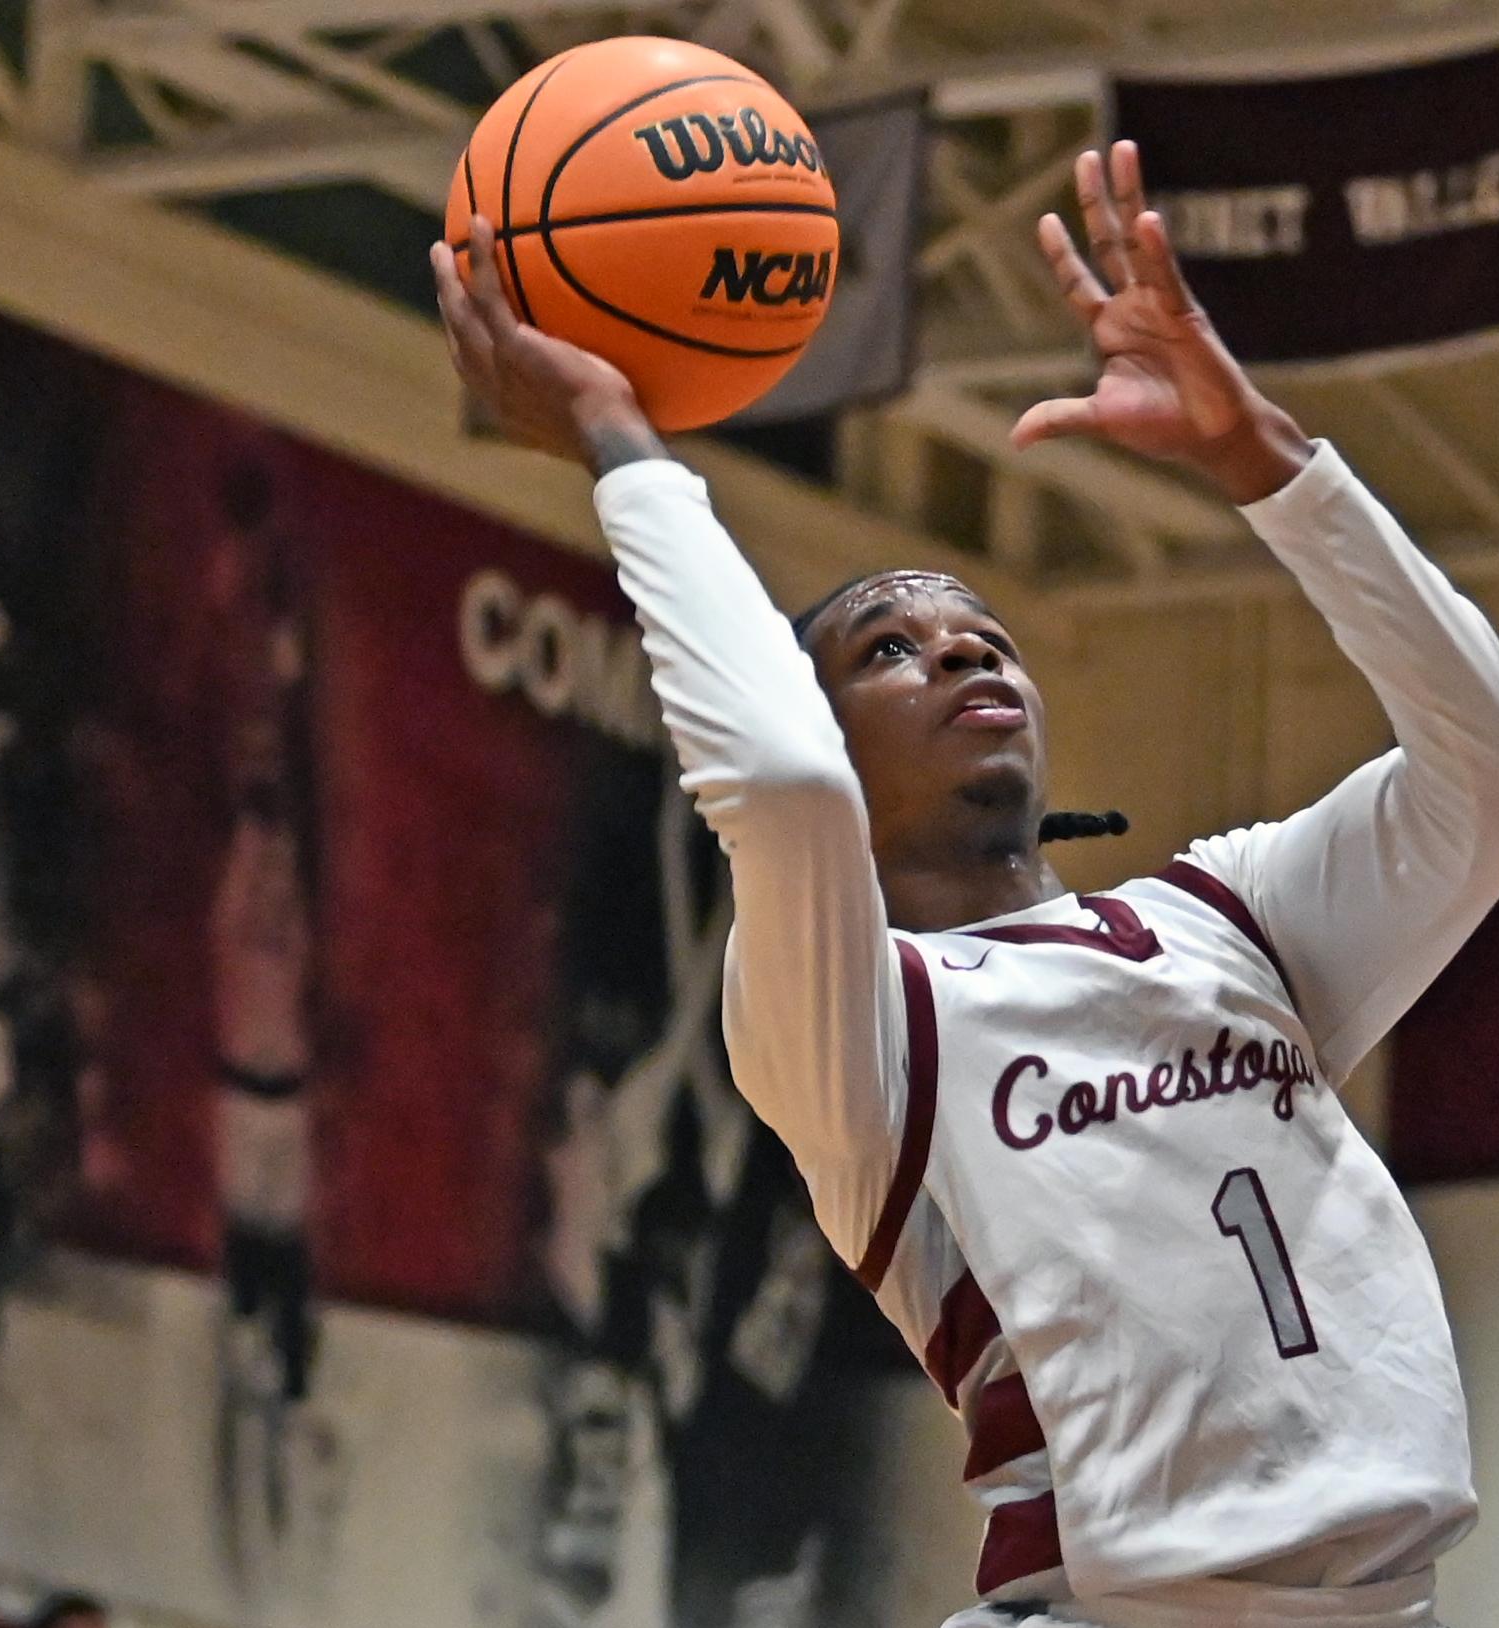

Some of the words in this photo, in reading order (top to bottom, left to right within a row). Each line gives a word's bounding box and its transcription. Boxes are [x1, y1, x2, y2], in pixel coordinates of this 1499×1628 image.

[633, 106, 828, 181] Wilso
[700, 247, 832, 305] NCAA
[991, 1026, 1318, 1151] Conestoga
[1210, 1166, 1319, 1360] 1
